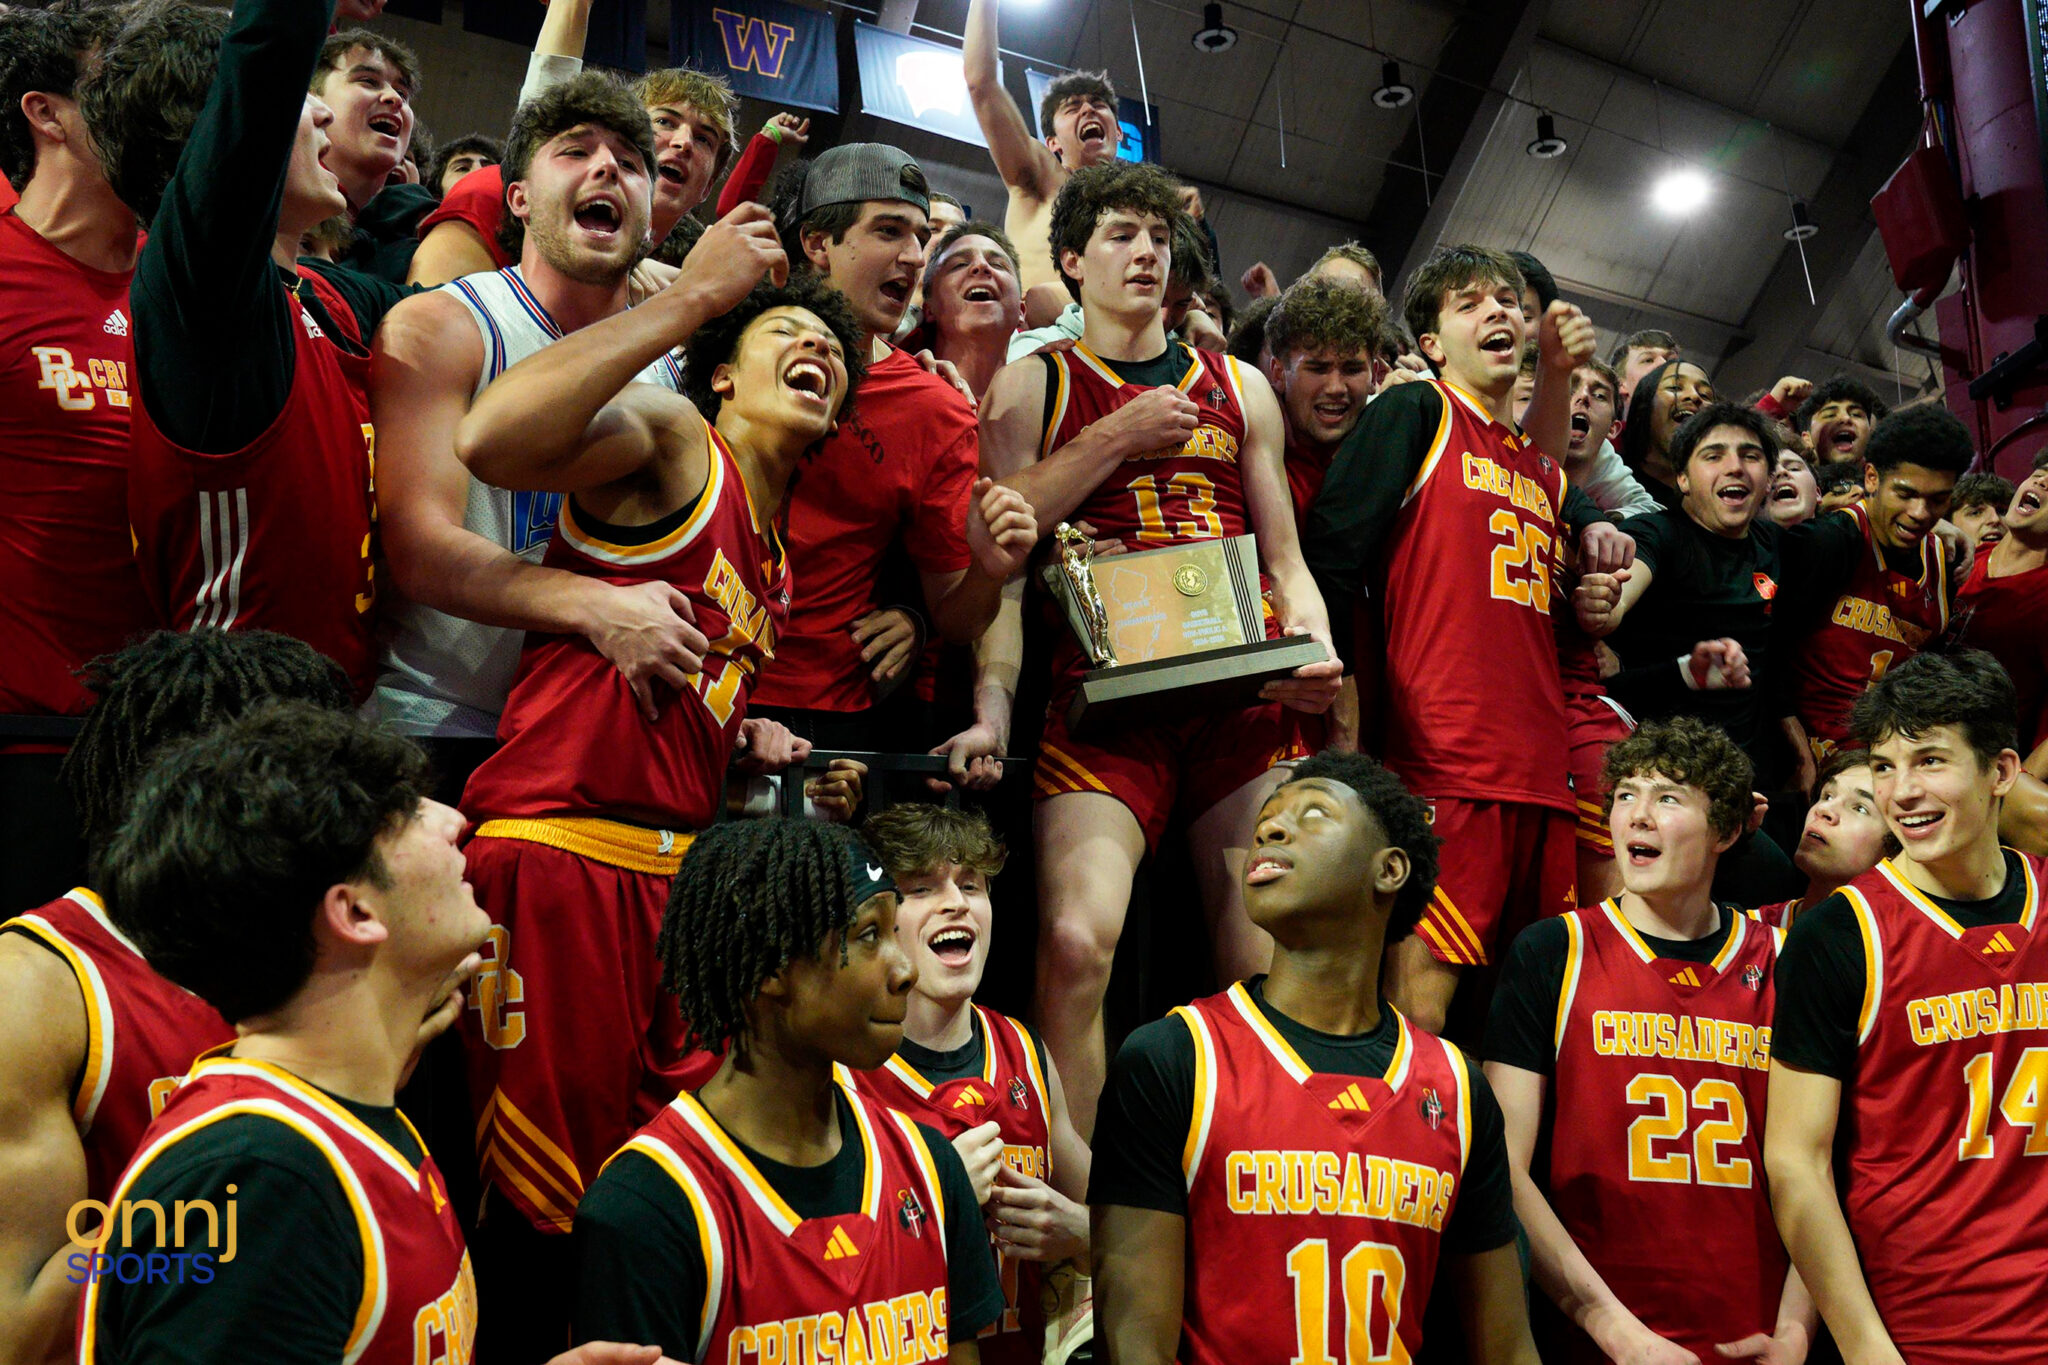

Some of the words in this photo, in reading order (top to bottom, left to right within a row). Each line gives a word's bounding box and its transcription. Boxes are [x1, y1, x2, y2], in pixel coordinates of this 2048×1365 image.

[713, 7, 795, 78] W
[1126, 472, 1224, 541] 13
[1489, 508, 1551, 615] 25
[1592, 1010, 1772, 1072] CRUSADERS
[1626, 1073, 1752, 1189] 22
[1958, 1047, 2048, 1162] 14
[1225, 1150, 1455, 1233] CRUSADERS
[727, 1286, 949, 1365] CRUSADERS
[1286, 1238, 1413, 1365] 10
